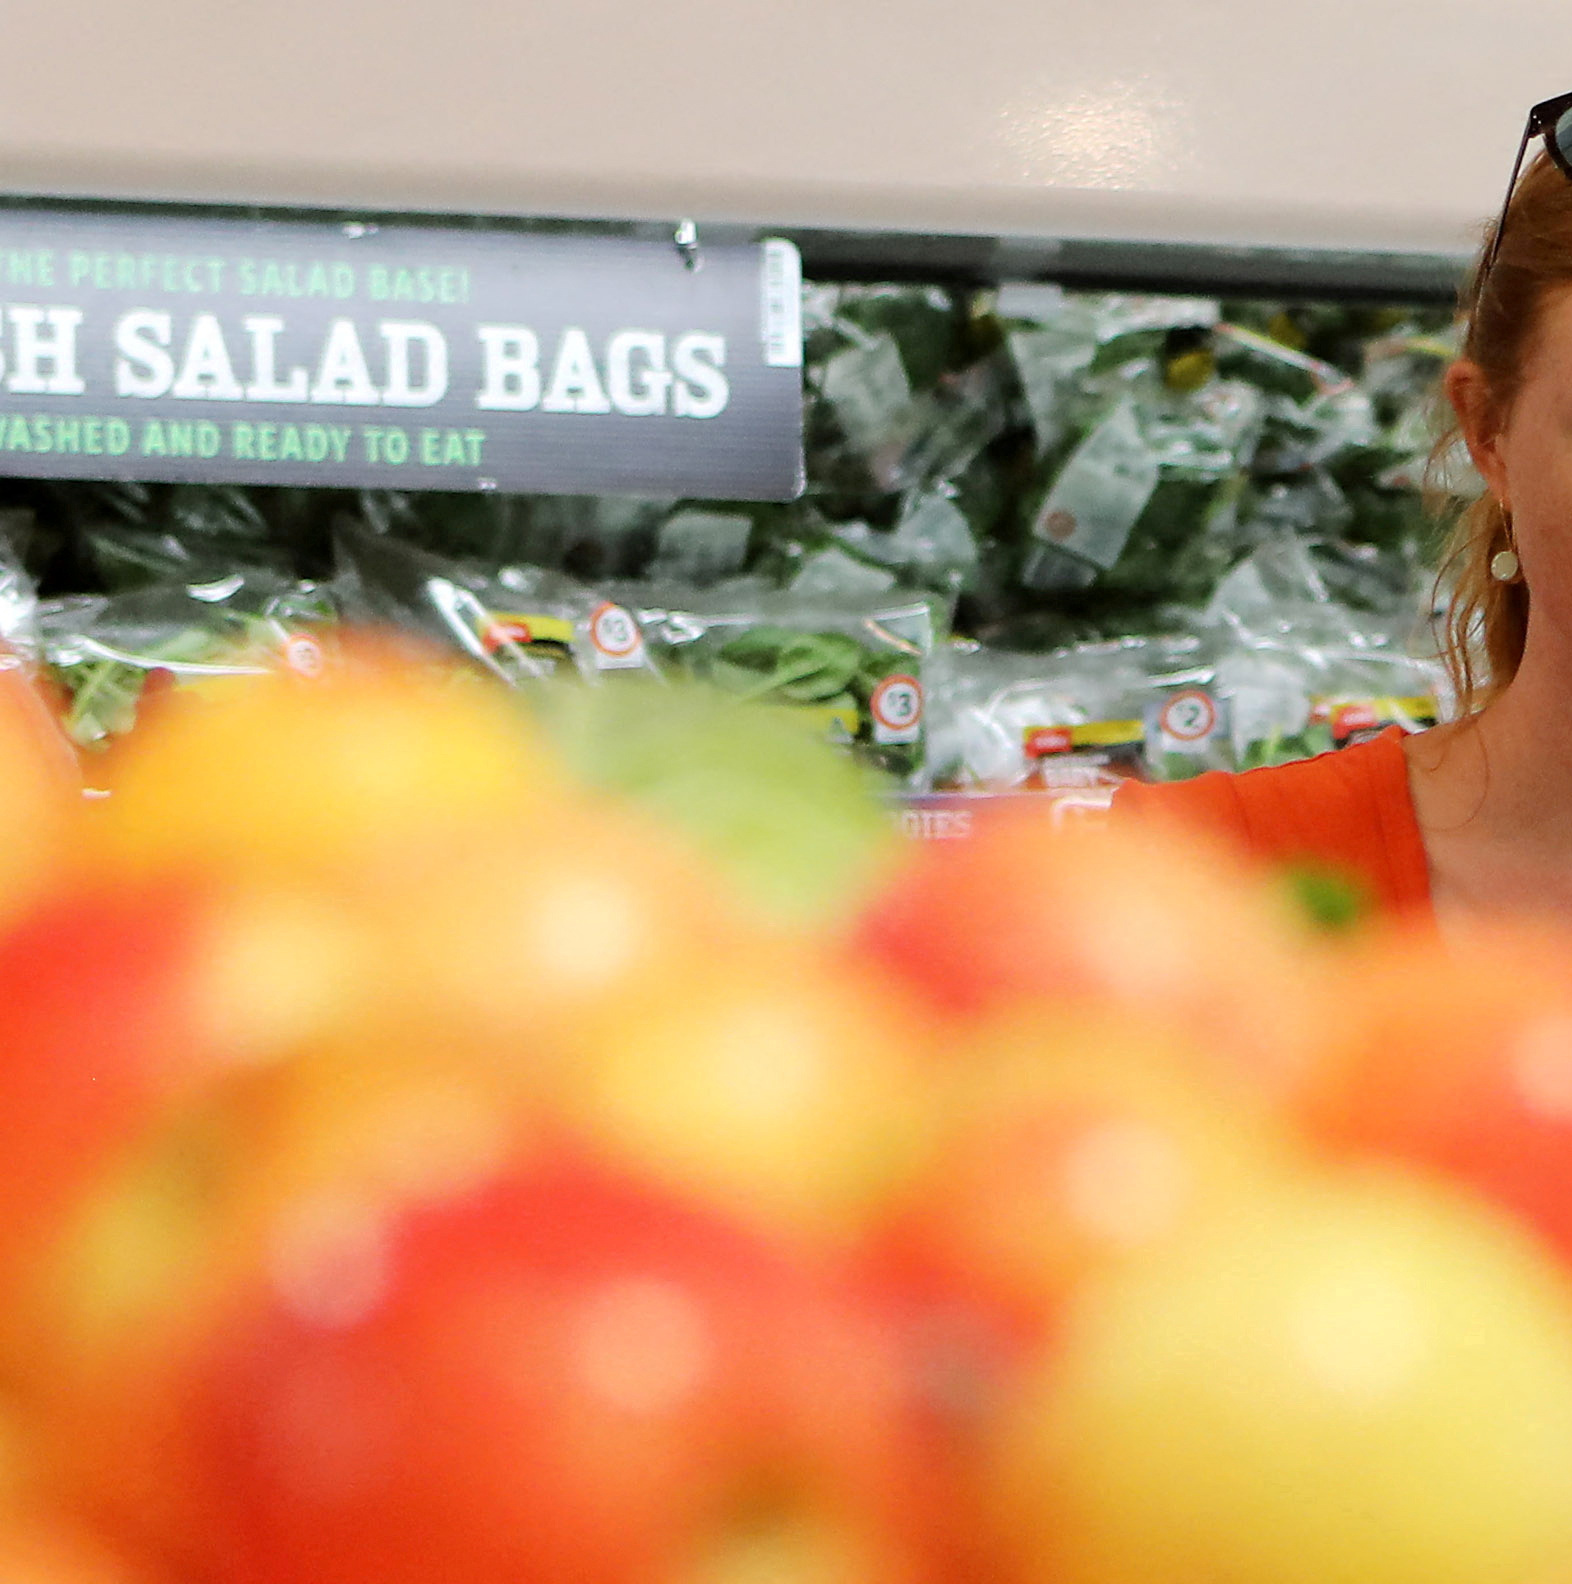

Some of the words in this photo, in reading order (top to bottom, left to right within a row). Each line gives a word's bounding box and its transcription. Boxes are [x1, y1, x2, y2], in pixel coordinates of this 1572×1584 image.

[0, 248, 55, 288] HE
[69, 249, 224, 294] PERFECT
[239, 256, 355, 300] SALAD
[0, 304, 86, 397] H
[114, 308, 449, 408] SALAD
[477, 323, 730, 419] BAGS
[0, 416, 131, 457] ASHED
[142, 419, 221, 459] AND
[233, 423, 351, 462] READY
[364, 427, 409, 465] TO
[421, 428, 487, 466] EAT
